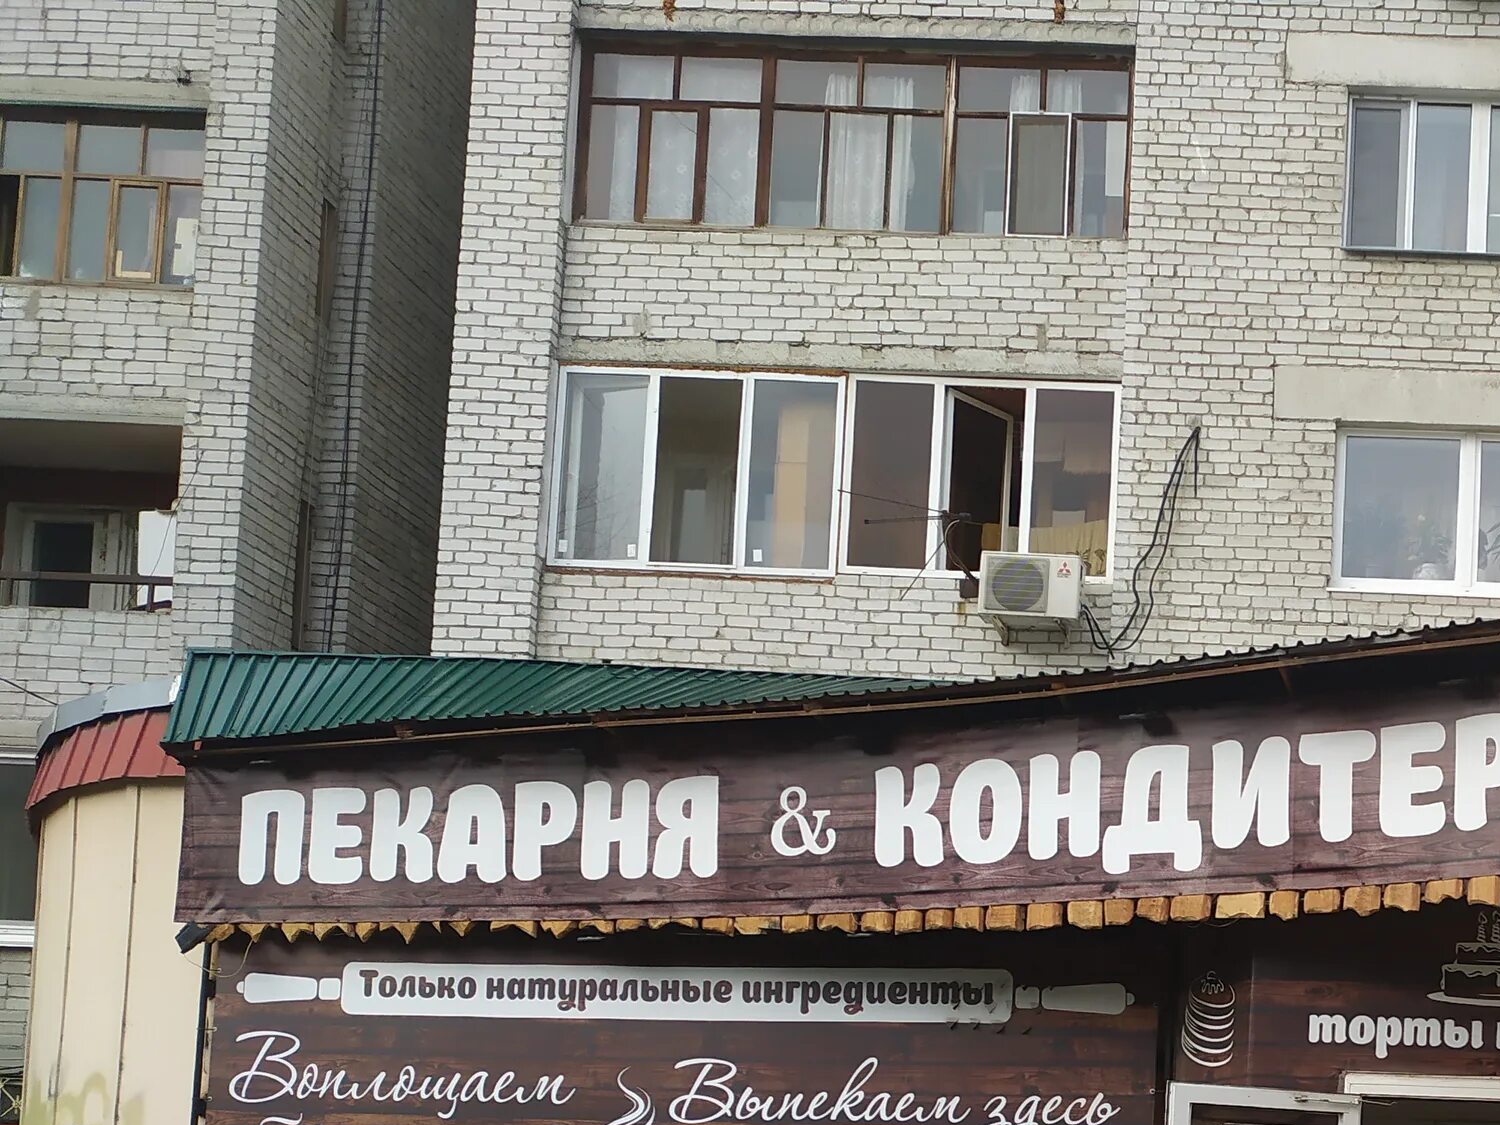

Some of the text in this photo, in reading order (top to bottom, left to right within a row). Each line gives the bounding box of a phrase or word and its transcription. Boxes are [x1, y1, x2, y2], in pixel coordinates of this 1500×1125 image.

[238, 775, 719, 886] ПЕКАРНЯ
[770, 785, 836, 857] &
[359, 969, 994, 1015] Только натуральные ингредиенты
[1307, 1012, 1484, 1059] торты
[229, 1030, 576, 1119] Воплощаем
[668, 1057, 971, 1125] Выпекаем
